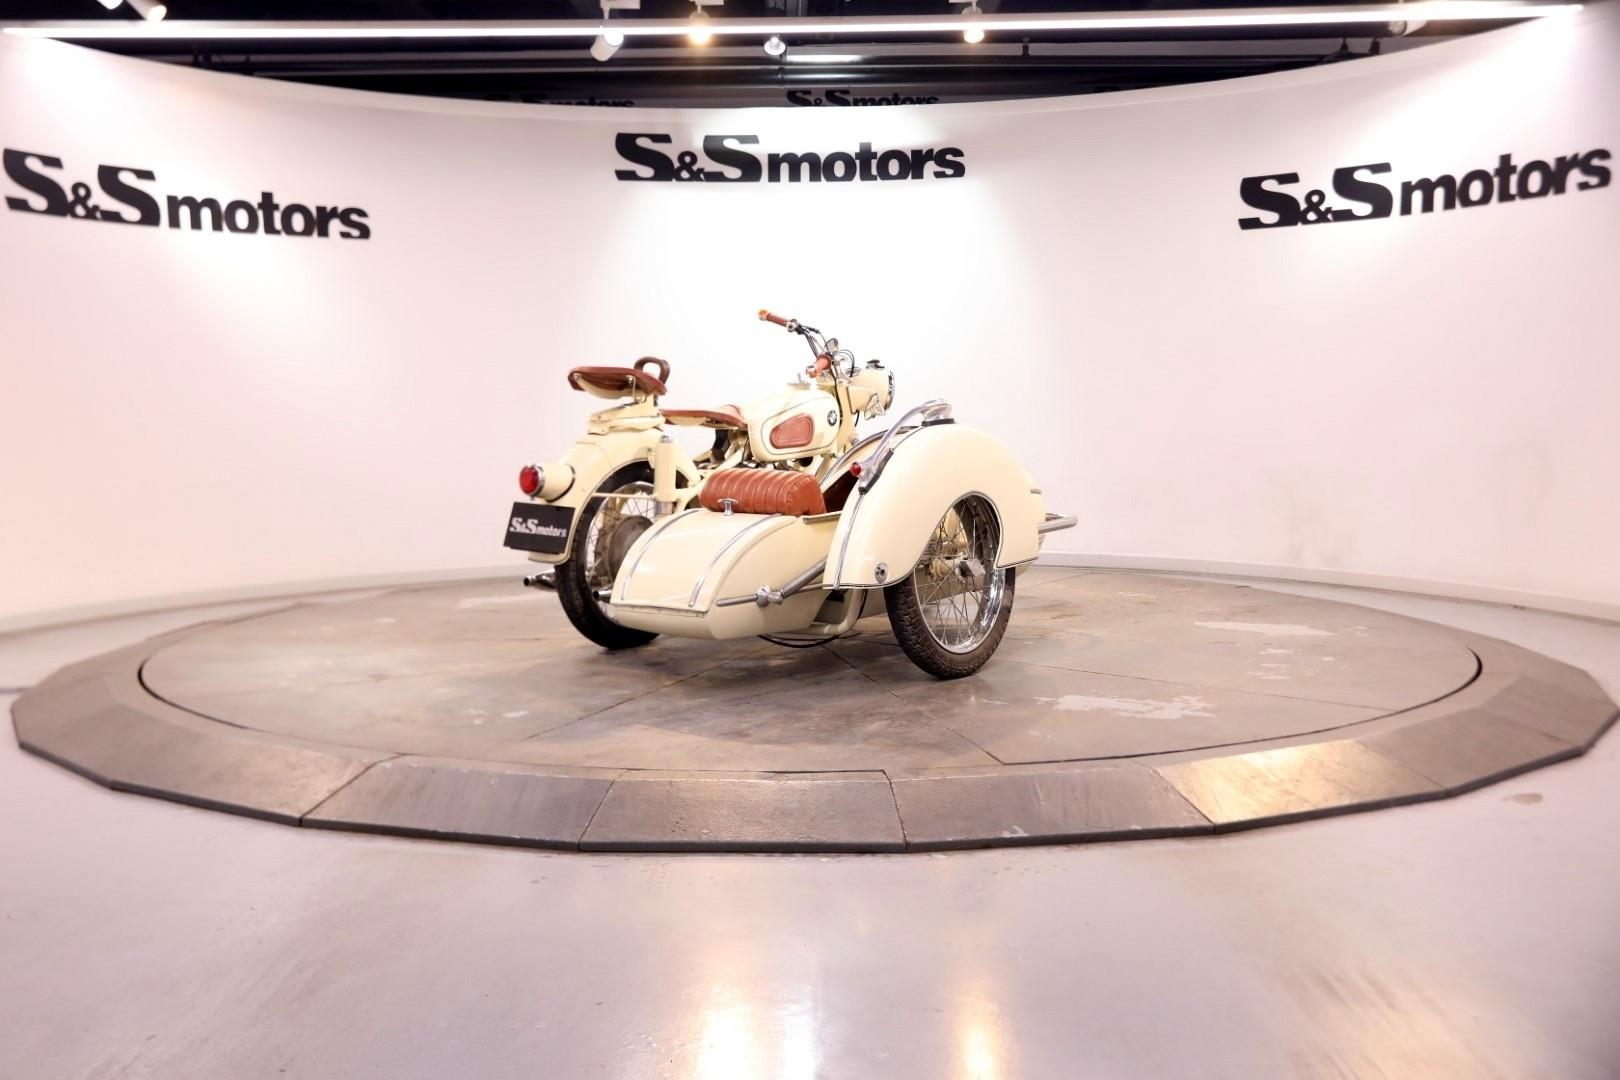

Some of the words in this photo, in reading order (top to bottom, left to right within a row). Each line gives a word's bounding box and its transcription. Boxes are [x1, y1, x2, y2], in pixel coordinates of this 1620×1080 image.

[615, 132, 762, 183] S&S
[767, 142, 965, 183] motors
[1238, 162, 1393, 230] S&S
[1400, 148, 1612, 216] motors
[3, 148, 160, 227] S&S
[166, 191, 371, 239] motors
[536, 525, 567, 538] motors
